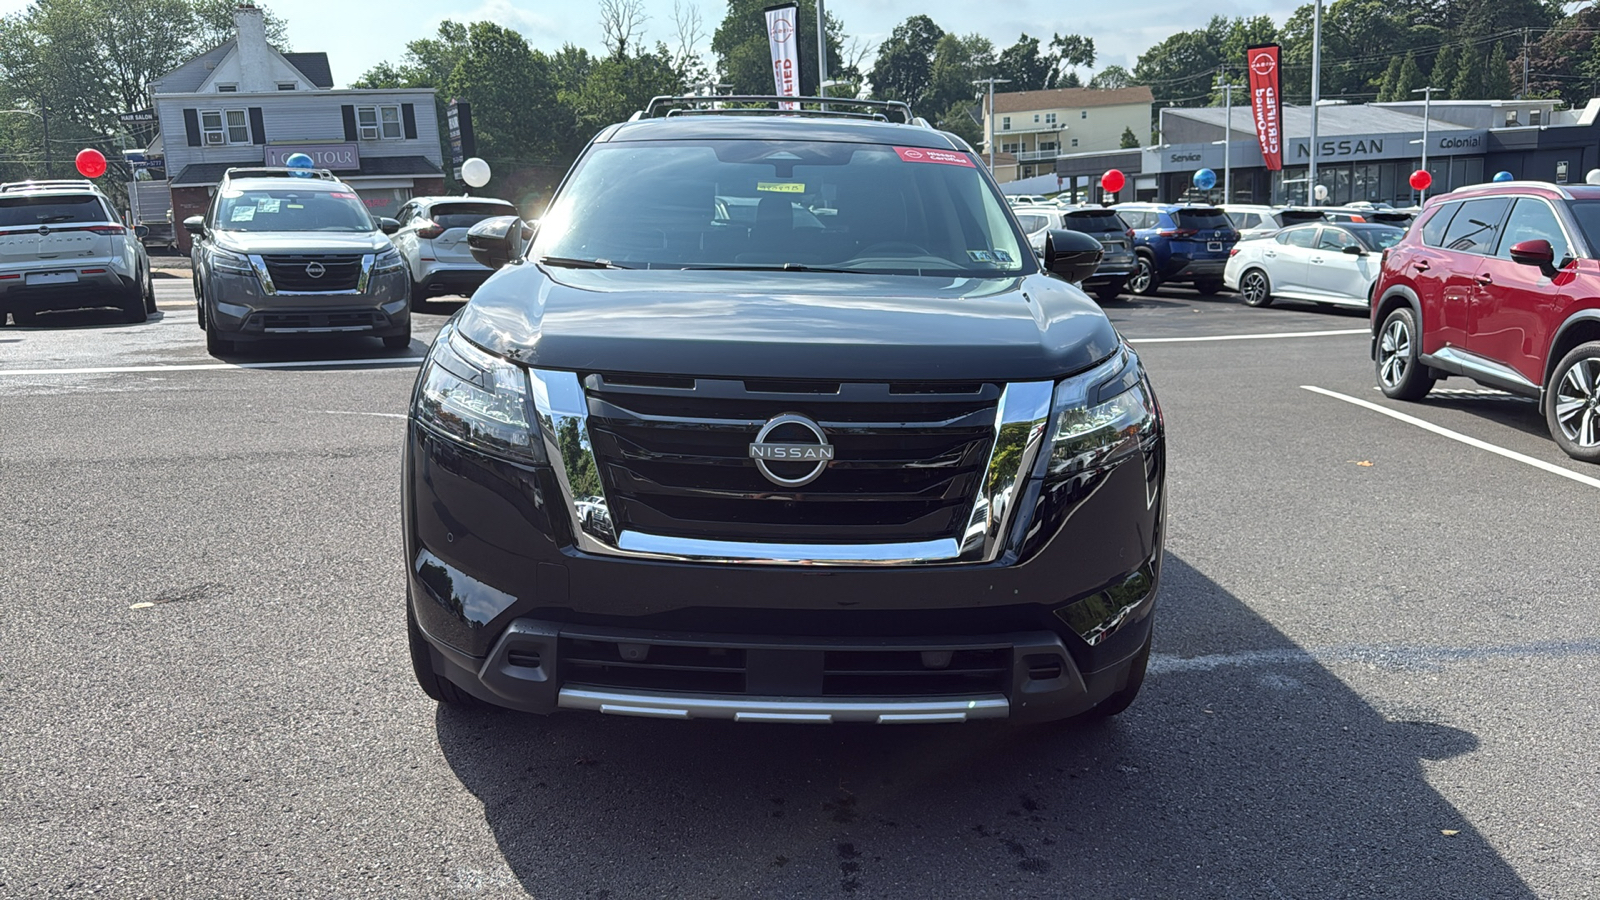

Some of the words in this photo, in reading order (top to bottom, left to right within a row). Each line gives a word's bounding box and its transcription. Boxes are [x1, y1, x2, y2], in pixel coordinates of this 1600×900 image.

[1440, 135, 1481, 149] Colonial
[1298, 139, 1384, 158] NISSAN
[281, 151, 352, 165] CTOUR
[926, 151, 956, 159] Nissan
[930, 155, 967, 164] Certified
[1171, 152, 1202, 163] Service
[752, 446, 832, 458] NISSAN
